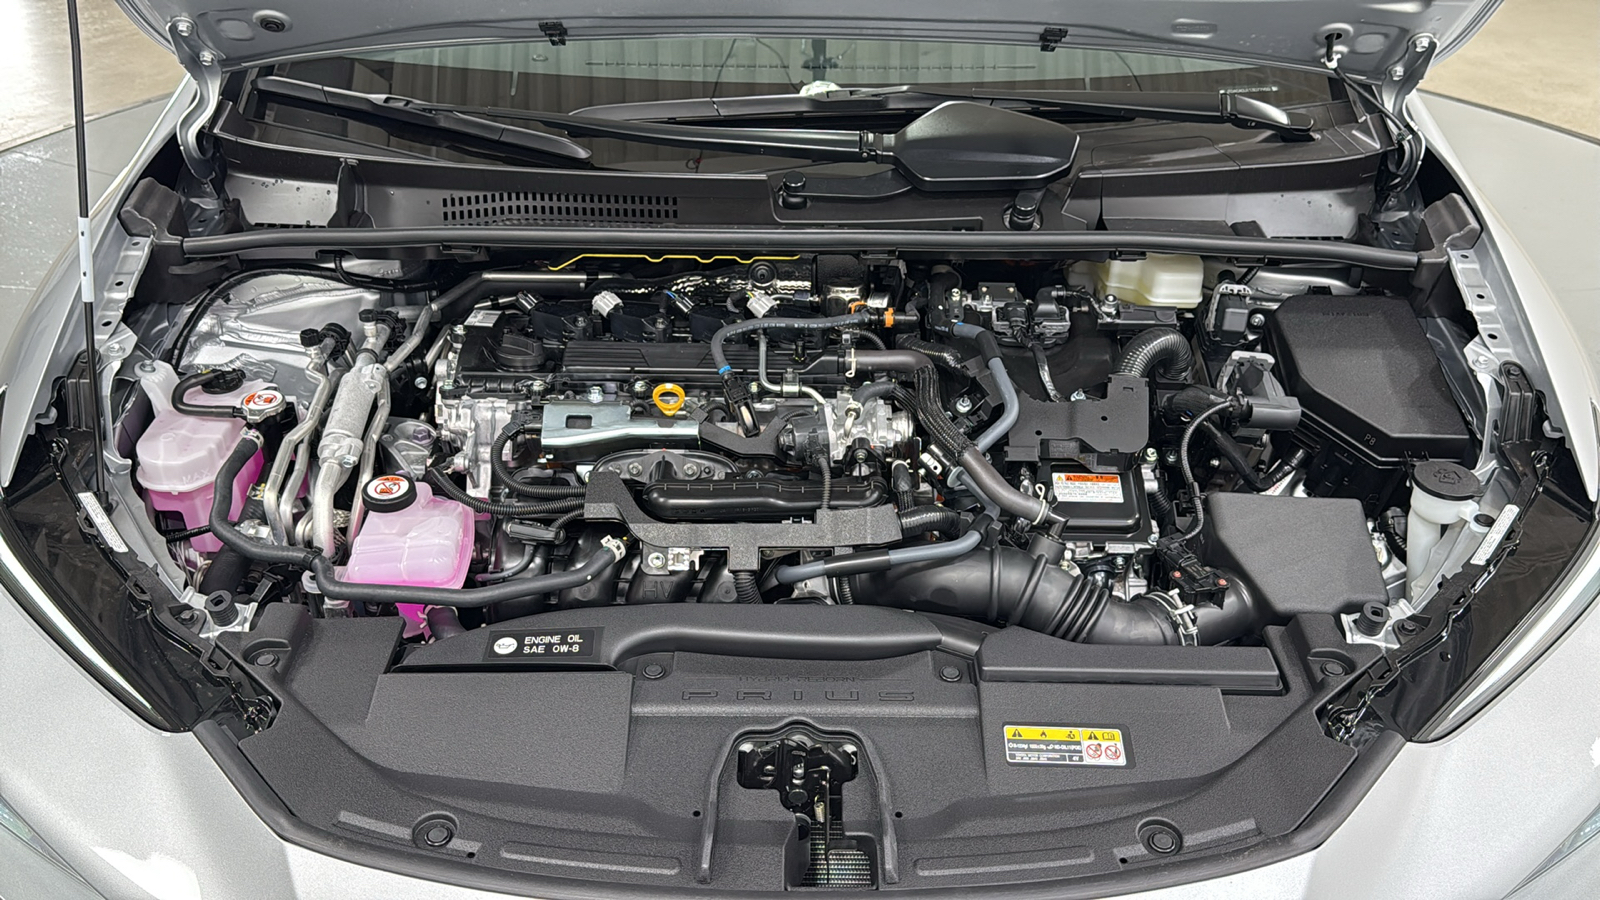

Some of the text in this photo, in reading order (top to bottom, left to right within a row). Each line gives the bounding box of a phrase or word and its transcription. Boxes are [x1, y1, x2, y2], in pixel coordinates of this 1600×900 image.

[182, 467, 211, 485] MAX
[642, 580, 674, 600] HV
[524, 634, 583, 644] ENGINE OIL
[523, 644, 580, 654] SAE 0W-8
[682, 690, 915, 702] PRIUS
